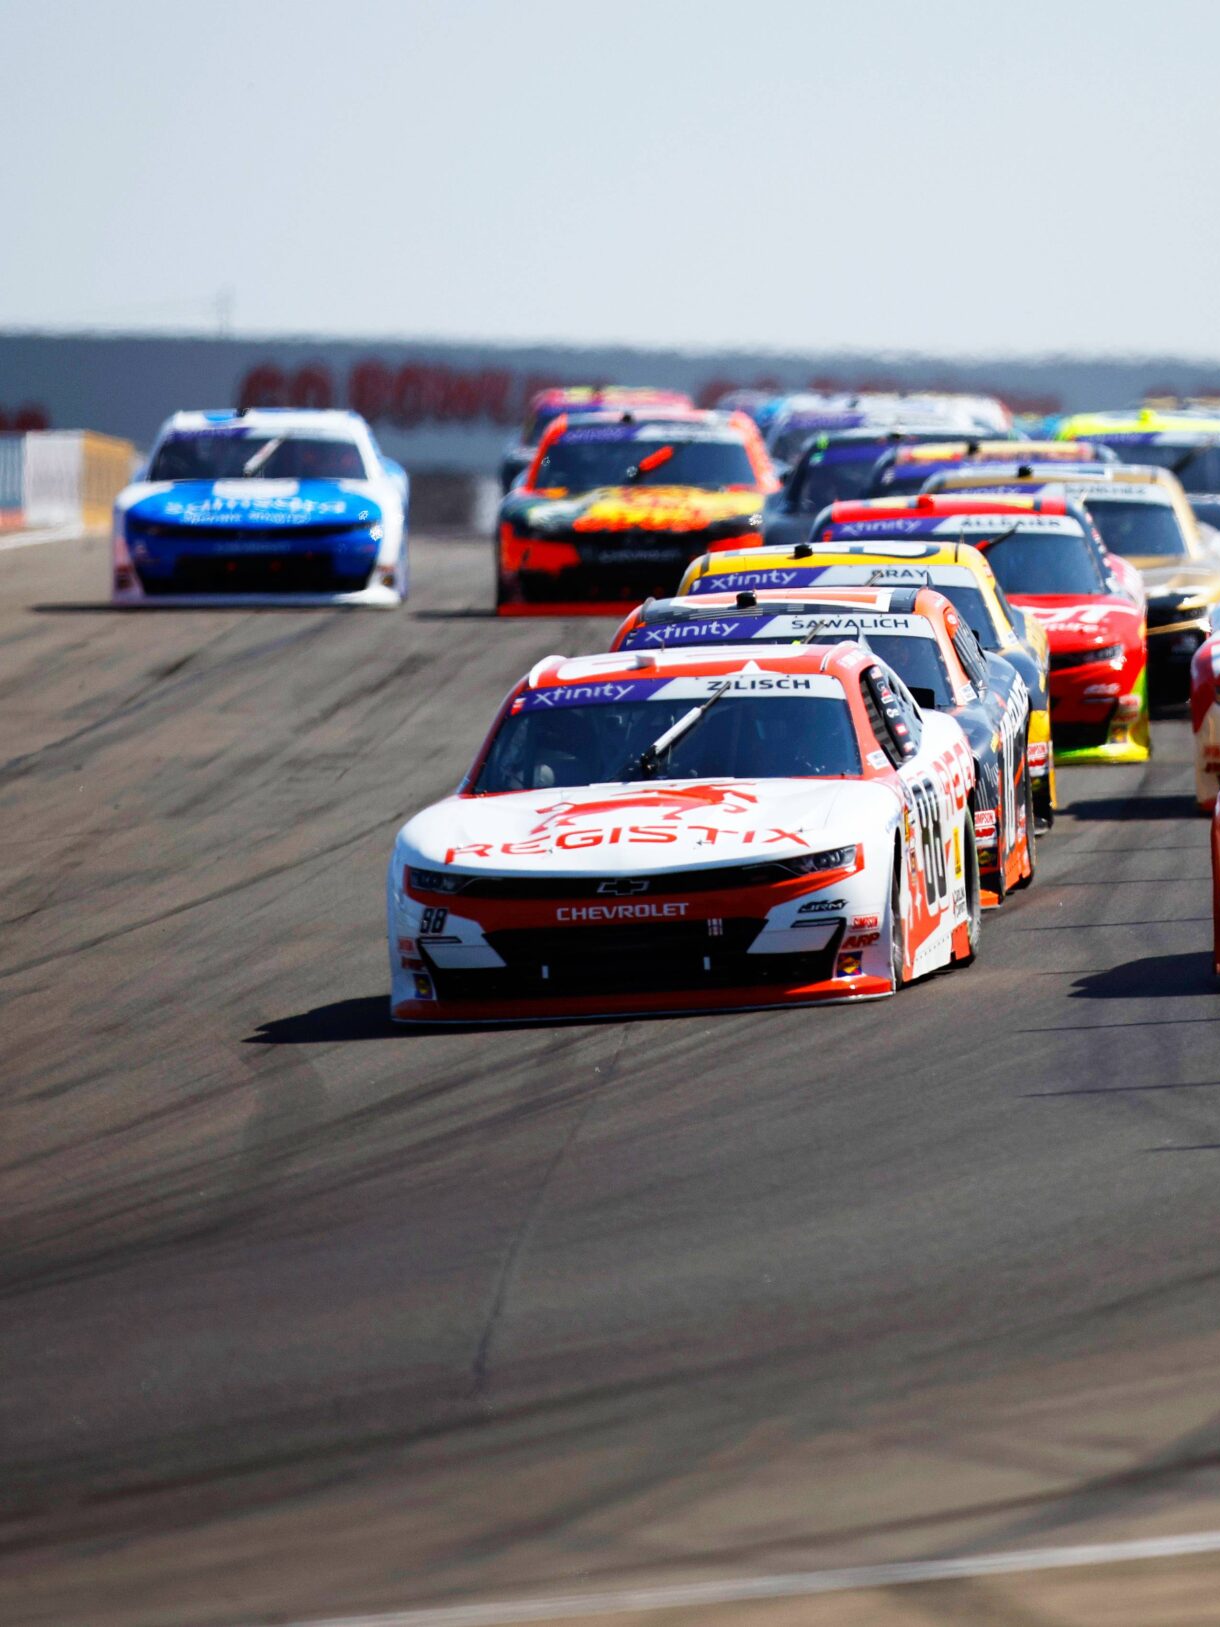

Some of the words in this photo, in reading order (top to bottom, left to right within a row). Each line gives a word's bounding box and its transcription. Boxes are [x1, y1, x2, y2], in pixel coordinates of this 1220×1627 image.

[840, 519, 922, 536] xfinity
[710, 570, 797, 589] xfinity
[644, 621, 740, 642] xfinity
[791, 618, 909, 630] SAWALICH
[533, 682, 635, 706] xfinity
[444, 825, 811, 865] REGISTIX
[556, 903, 689, 921] CHEVROLET
